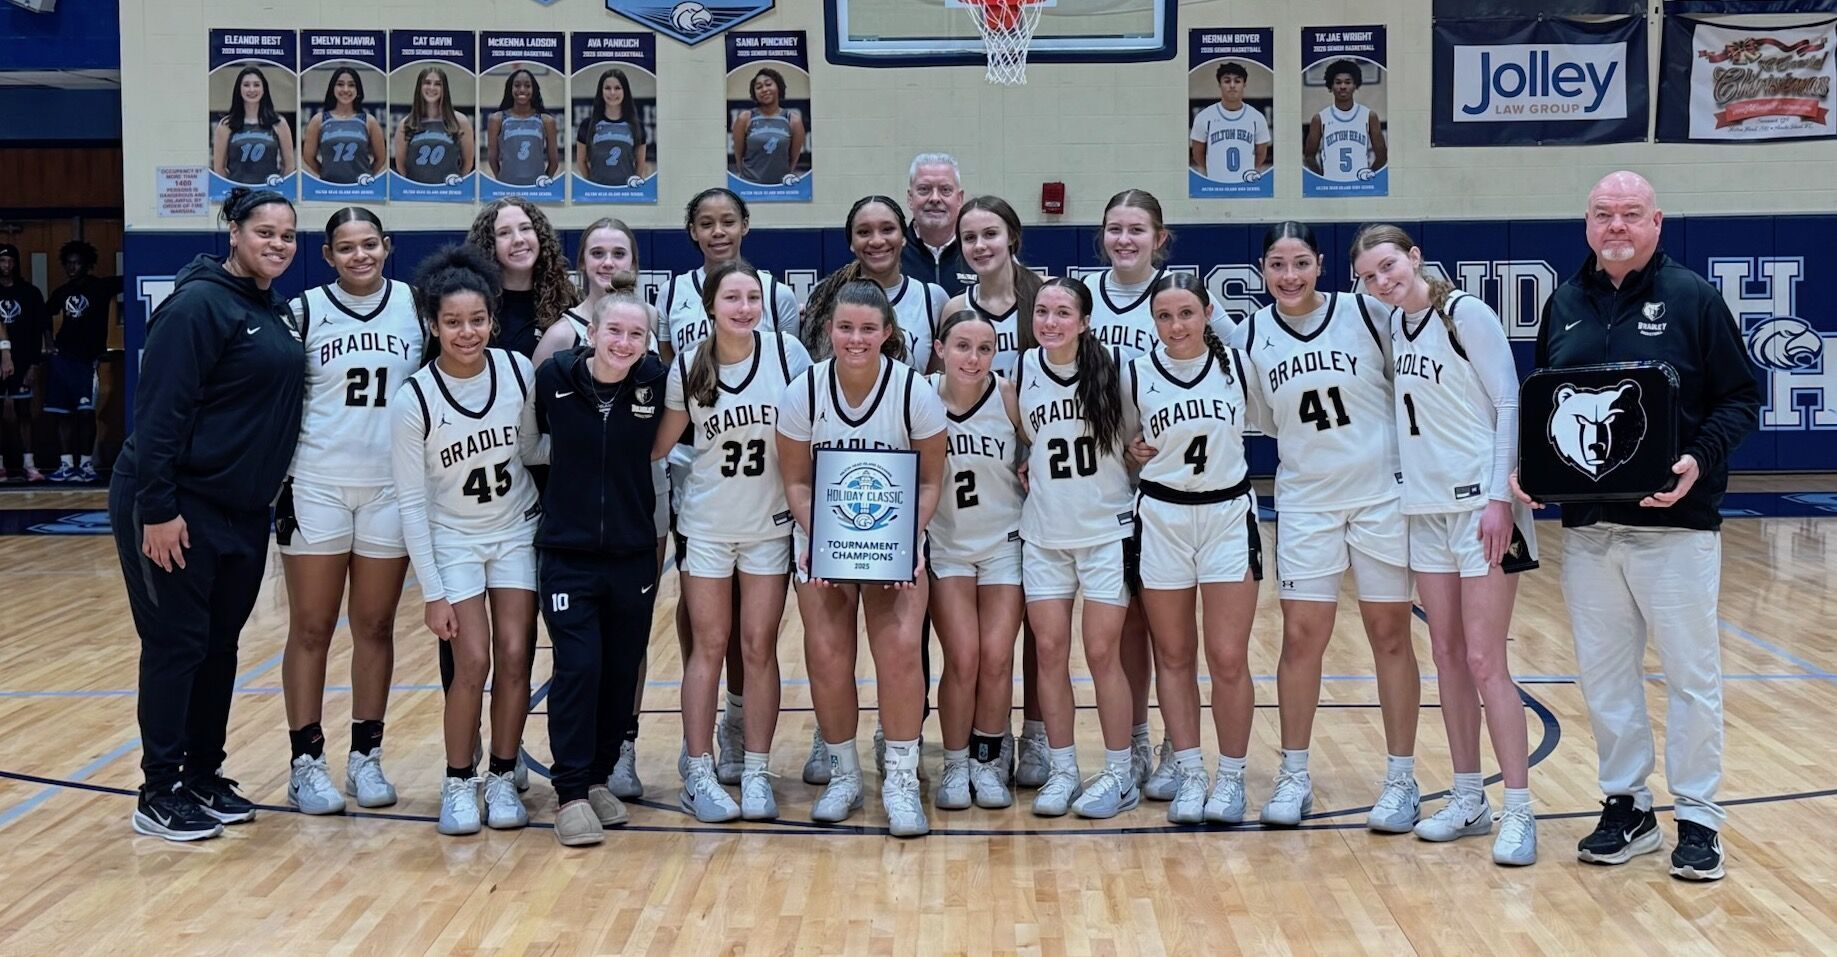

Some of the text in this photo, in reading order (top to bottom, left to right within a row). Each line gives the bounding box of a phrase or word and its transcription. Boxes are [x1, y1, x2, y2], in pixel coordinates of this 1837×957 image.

[224, 35, 281, 45] ELEANOR BEST
[311, 36, 375, 46] EMELYN CHAVIRA
[412, 36, 452, 46] CAT GAVIN
[488, 38, 557, 47] McKENNA LADSON
[587, 38, 639, 48] AVA PANKUCH
[736, 37, 798, 47] SANIA PINCKNEY
[1202, 34, 1260, 43] HERNAN BOYER
[1315, 32, 1372, 42] TA'JAE WRIGHT
[1462, 50, 1618, 115] Jolley
[1495, 104, 1580, 115] LAW GROUP
[1210, 128, 1236, 145] HILTON
[240, 142, 266, 162] 10
[332, 142, 358, 162] 12
[416, 145, 445, 166] 20
[517, 140, 531, 160] 3
[605, 146, 622, 166] 2
[1226, 147, 1240, 172] 0
[1339, 147, 1353, 172] 5
[1091, 325, 1159, 352] ADLEY
[320, 331, 410, 367] BRADLEY
[1268, 350, 1358, 394] BRADLEY
[1394, 353, 1443, 385] ADLEY
[345, 367, 388, 408] 21
[1029, 398, 1086, 434] BRADL
[1299, 386, 1352, 431] 41
[1403, 393, 1420, 436] 1
[1150, 399, 1236, 440] BRADLEY
[945, 433, 1006, 461] ADLEY
[1184, 434, 1208, 476] 4
[720, 439, 766, 478] 33
[1047, 435, 1098, 480] 20
[462, 458, 513, 504] 45
[954, 469, 979, 509] 2
[826, 488, 904, 505] HOLIDAY CLASSIC
[827, 540, 899, 551] TOURNAMENT
[832, 551, 893, 561] CHAMPIONS
[854, 562, 870, 570] 2025
[551, 593, 569, 612] 10
